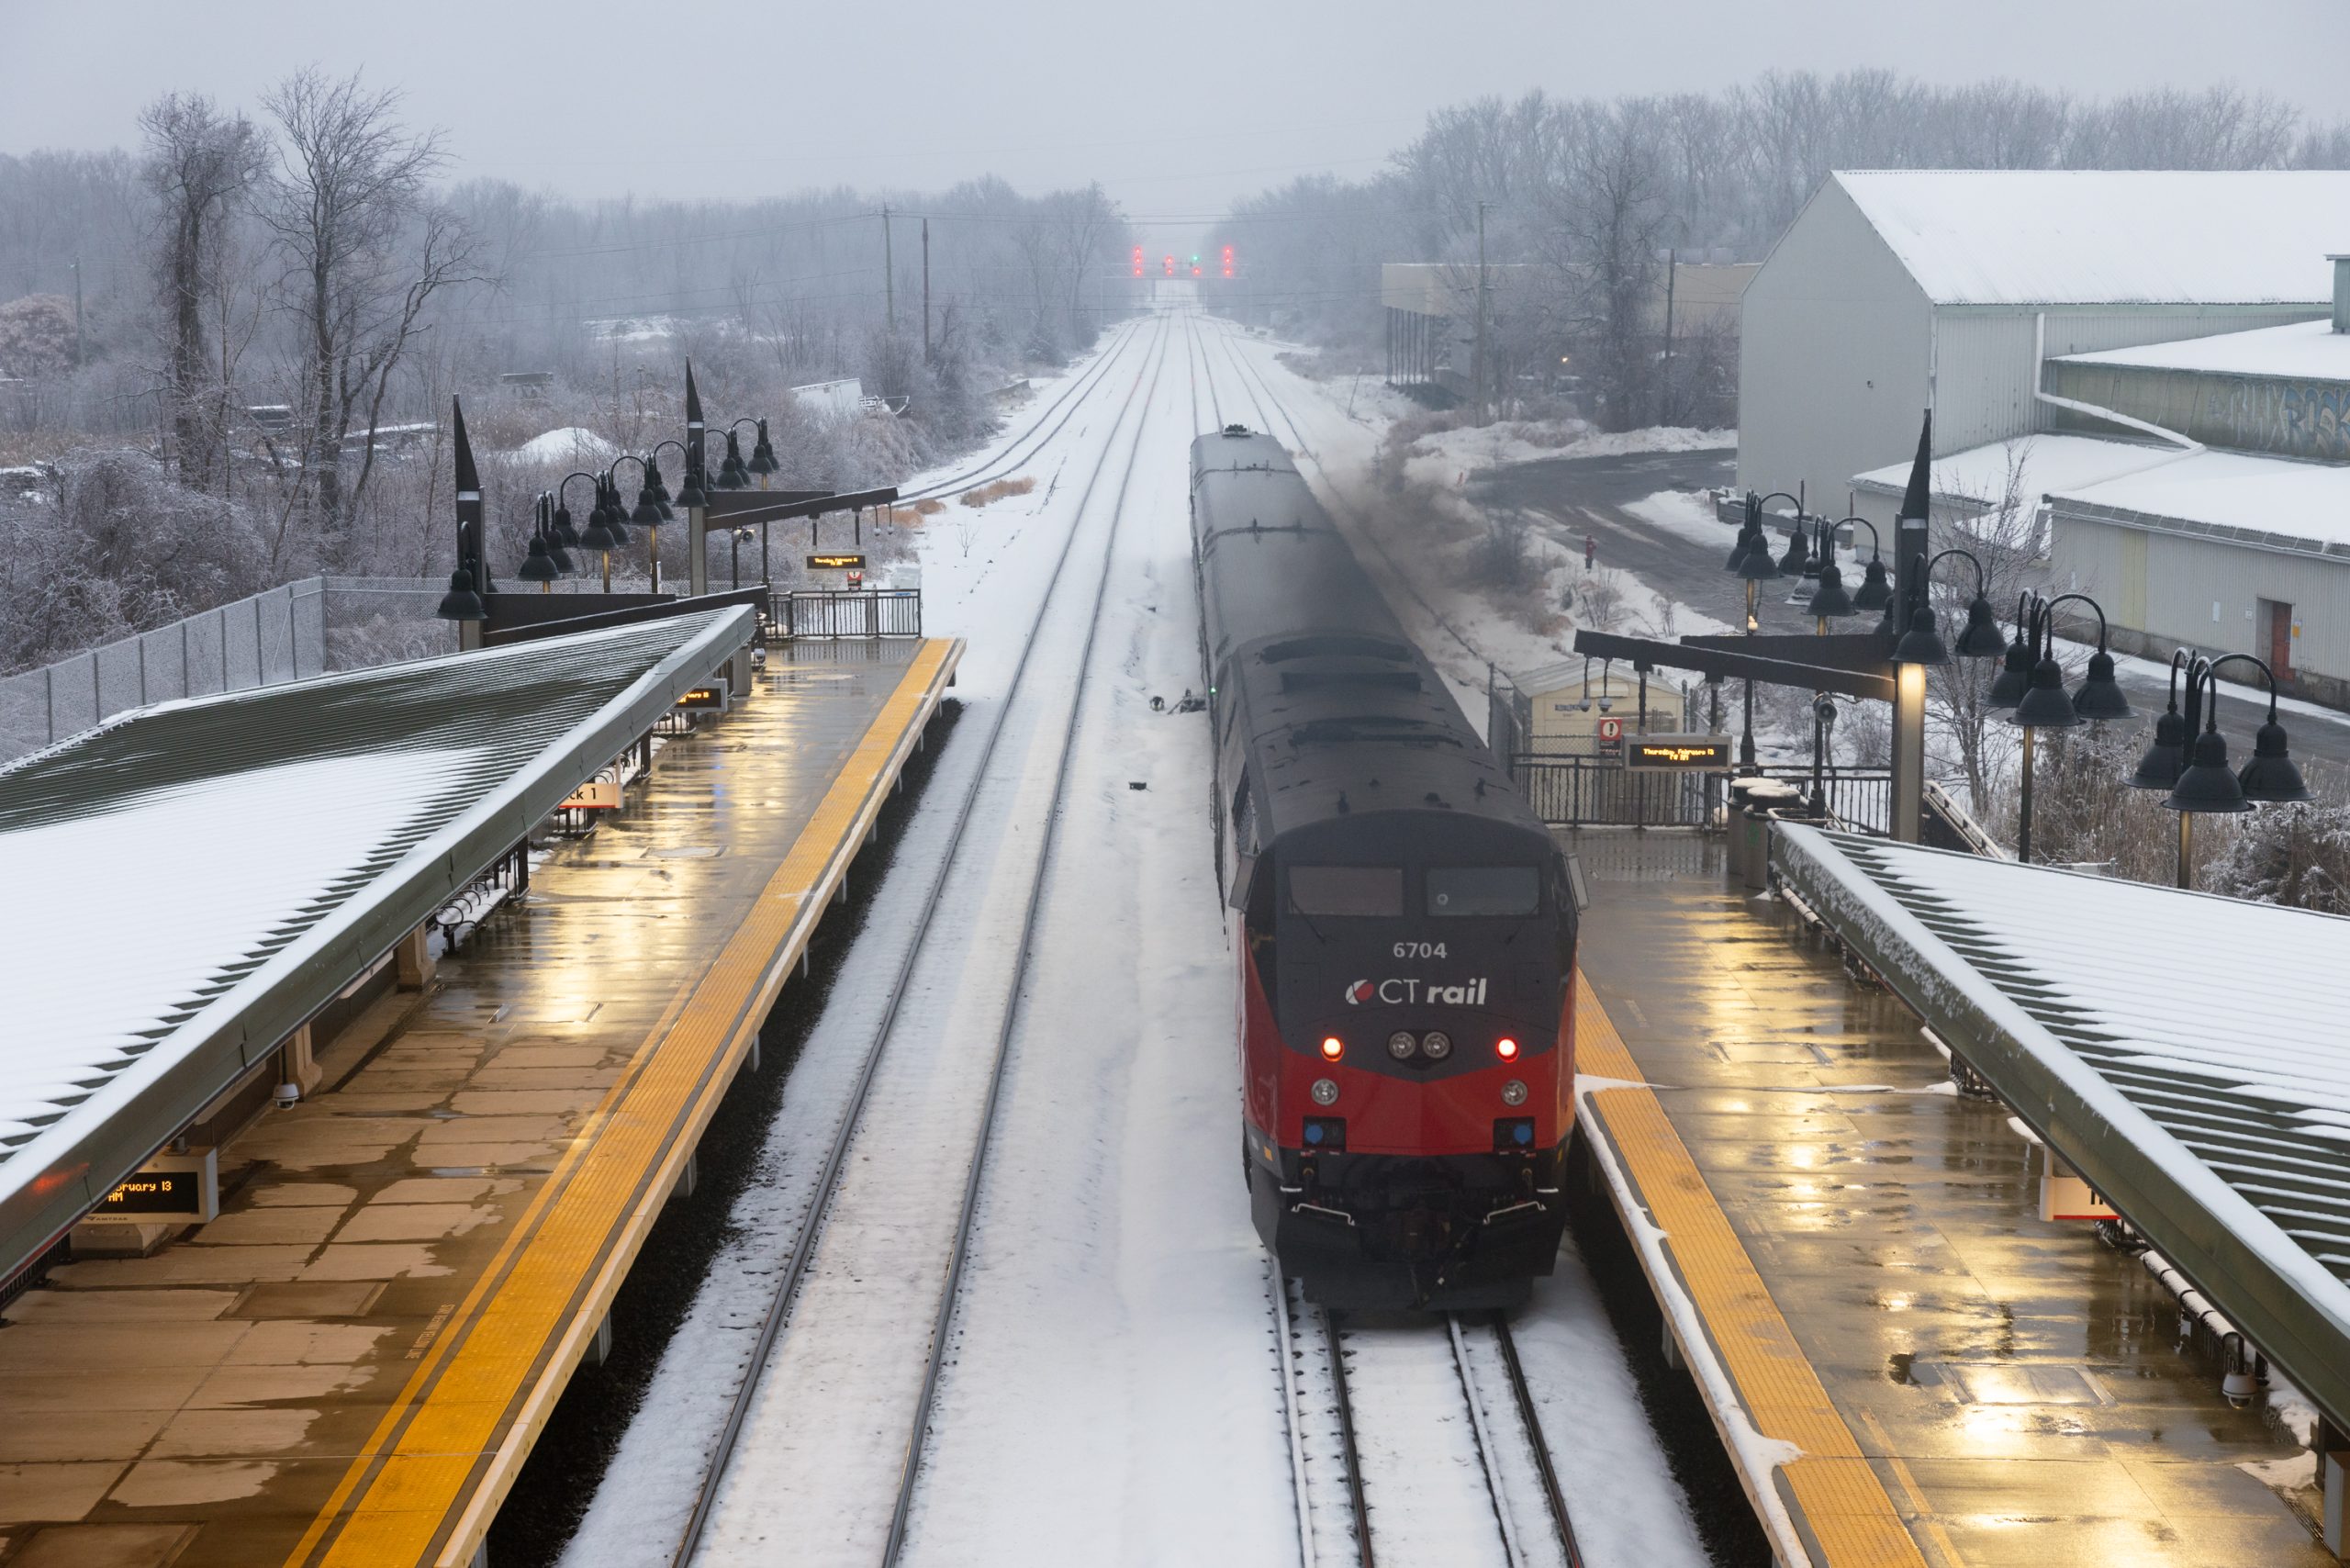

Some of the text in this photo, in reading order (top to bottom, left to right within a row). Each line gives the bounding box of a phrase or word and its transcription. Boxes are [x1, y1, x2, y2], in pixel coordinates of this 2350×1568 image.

[1393, 942, 1448, 958] 6704
[1379, 978, 1487, 1005] CT rail
[162, 1181, 173, 1192] 13
